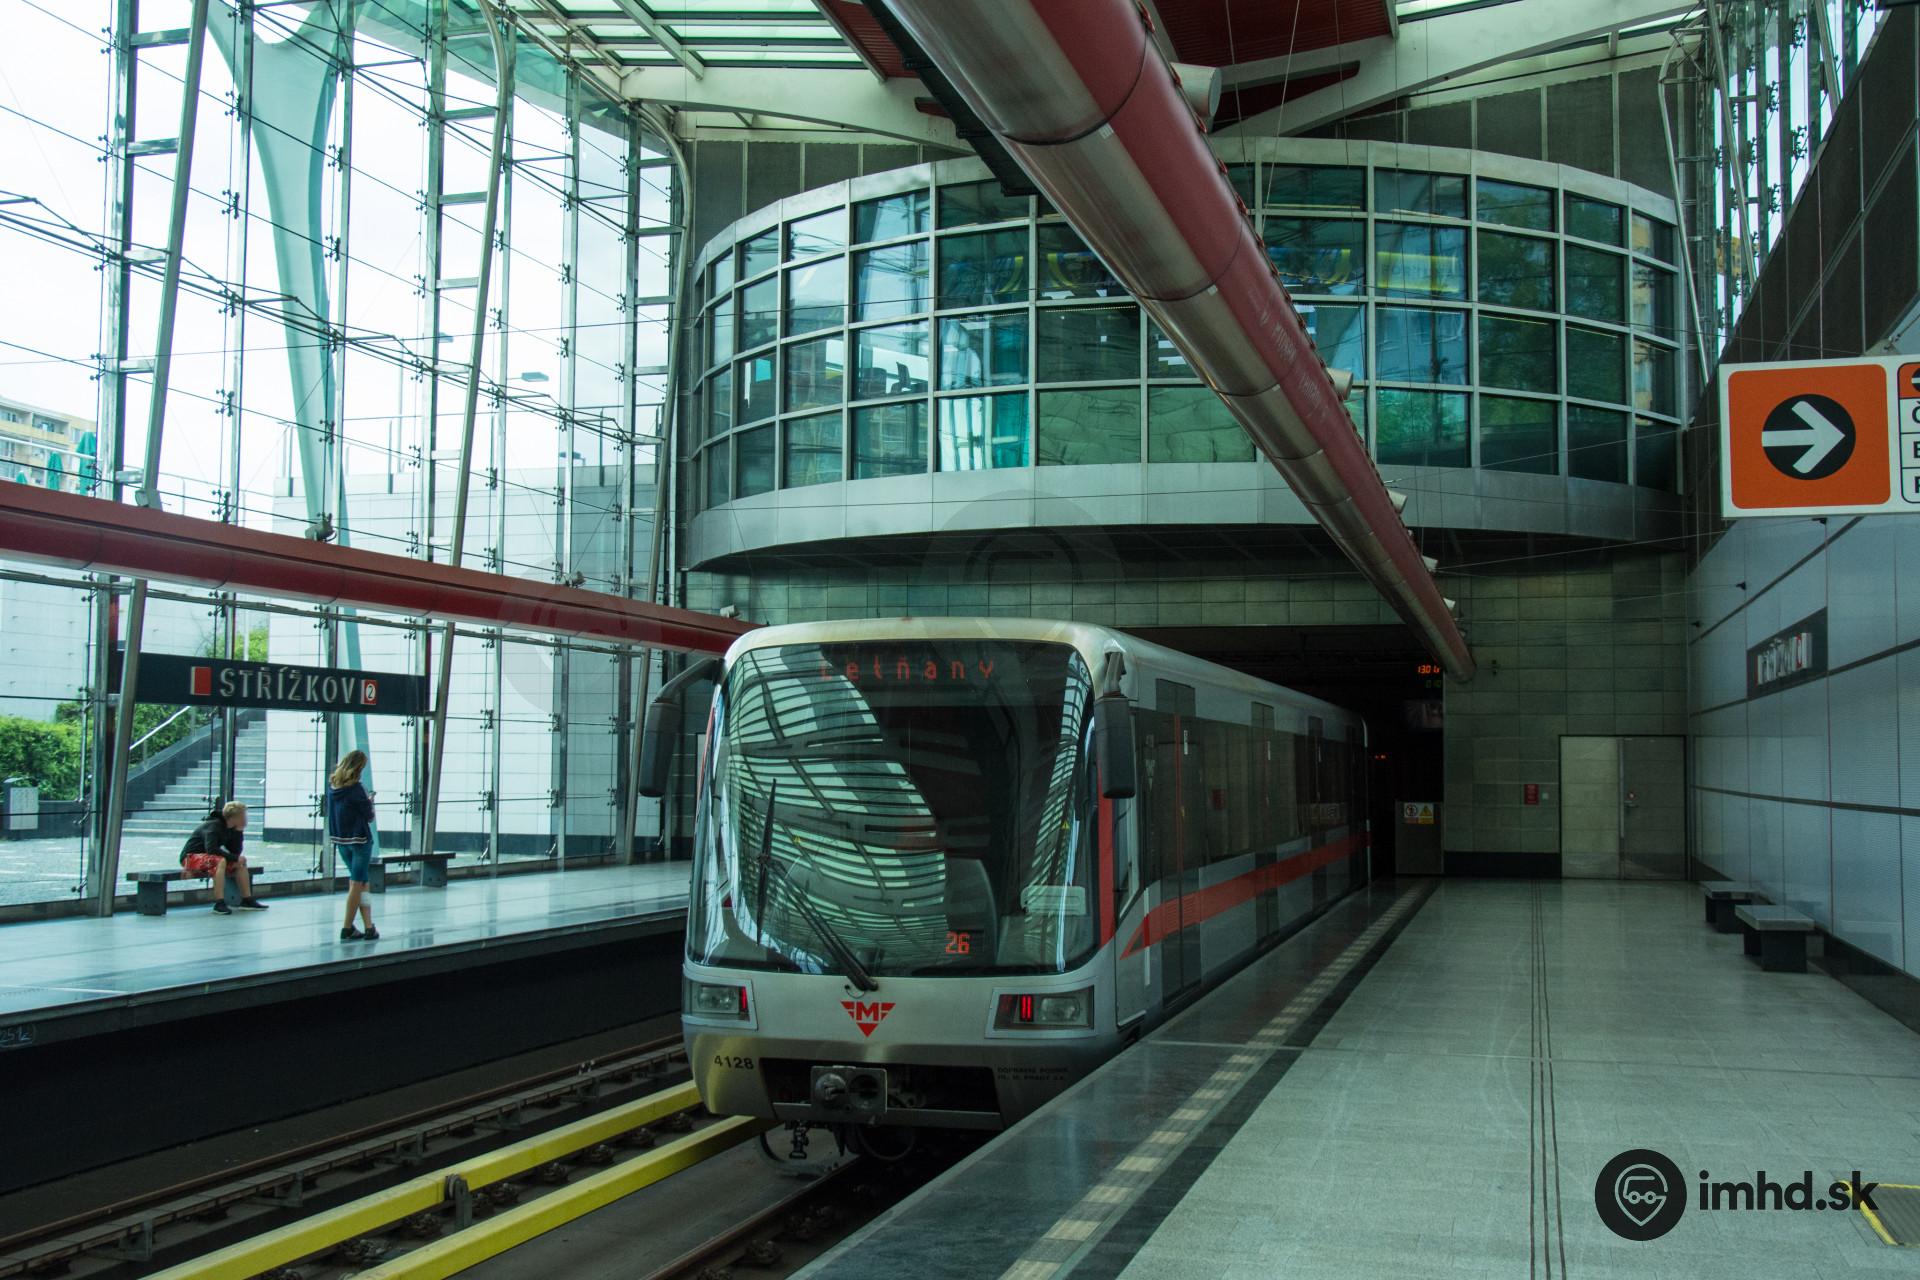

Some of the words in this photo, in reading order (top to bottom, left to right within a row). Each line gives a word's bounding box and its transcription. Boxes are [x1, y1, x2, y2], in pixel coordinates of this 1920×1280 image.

[219, 666, 356, 704] STŘÍŽKOV
[945, 931, 970, 954] 26
[714, 1055, 754, 1070] 4128
